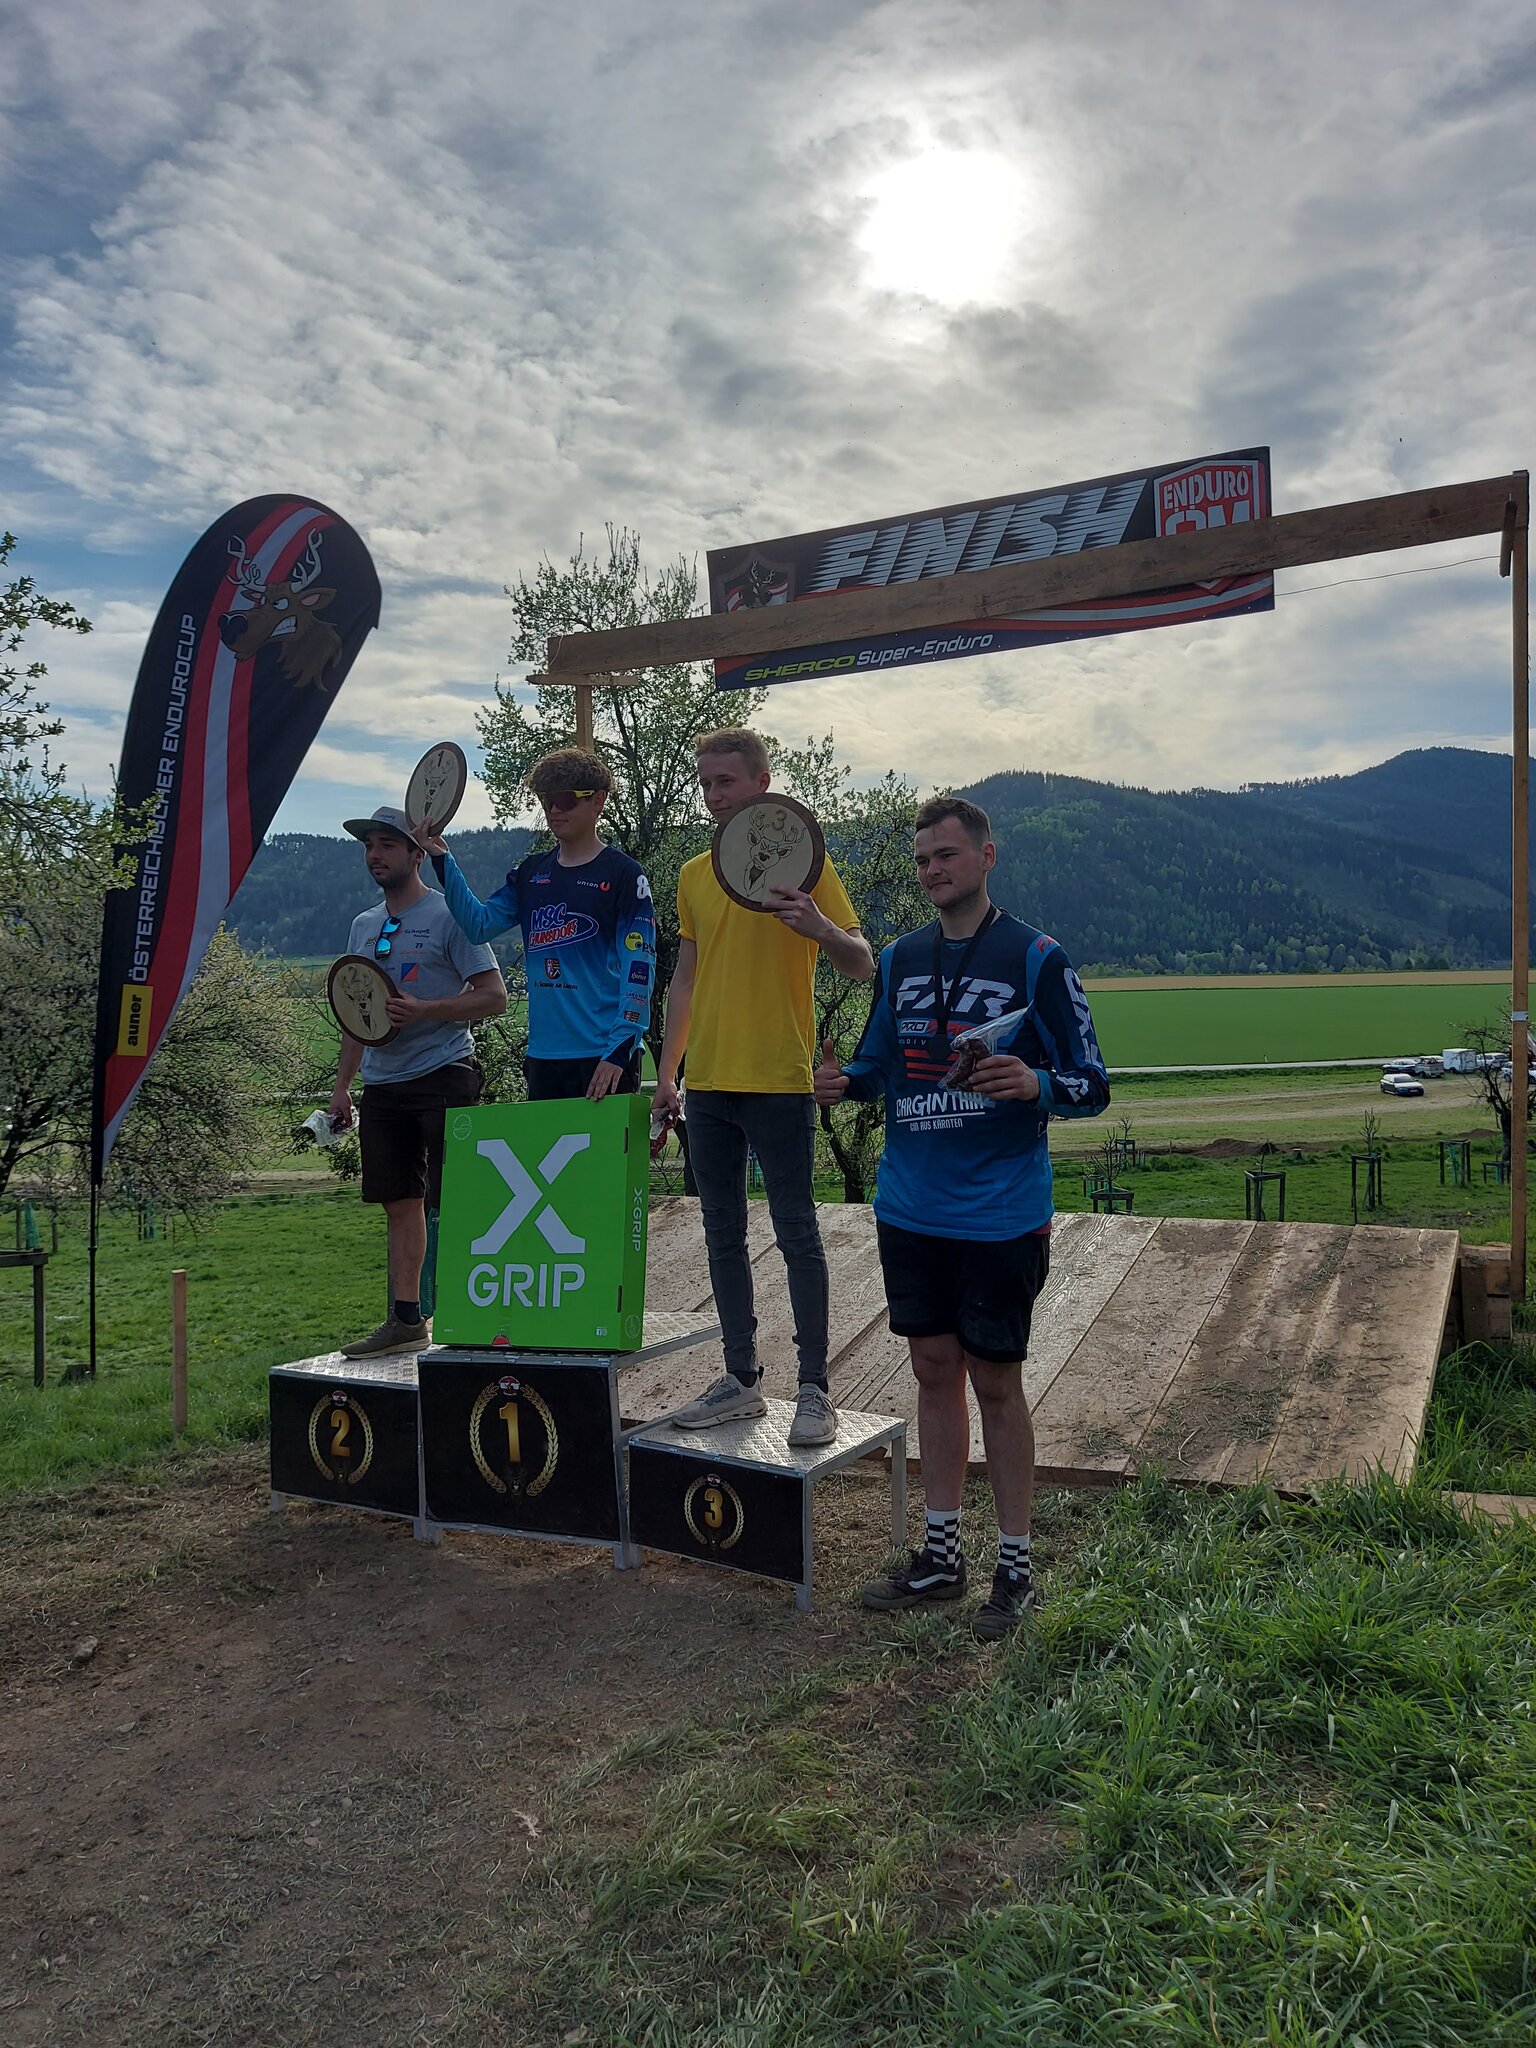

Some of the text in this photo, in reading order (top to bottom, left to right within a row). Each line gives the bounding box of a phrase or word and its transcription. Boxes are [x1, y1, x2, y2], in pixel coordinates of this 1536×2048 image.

[1163, 470, 1249, 510] ENDURO
[805, 478, 1147, 594] FINISH
[744, 632, 993, 681] SHERCO Super-Enduro
[161, 614, 197, 753] ENDUROCUP
[772, 809, 788, 831] 3
[576, 880, 599, 889] union
[531, 902, 568, 932] MSC
[348, 966, 361, 982] 2
[895, 974, 1017, 1018] FXR
[127, 994, 142, 1047] auner
[920, 1119, 932, 1131] AUS
[470, 1133, 591, 1255] X
[467, 1262, 586, 1308] GRIP
[330, 1409, 351, 1457] 2
[498, 1401, 521, 1463] 1
[704, 1487, 724, 1529] 3
